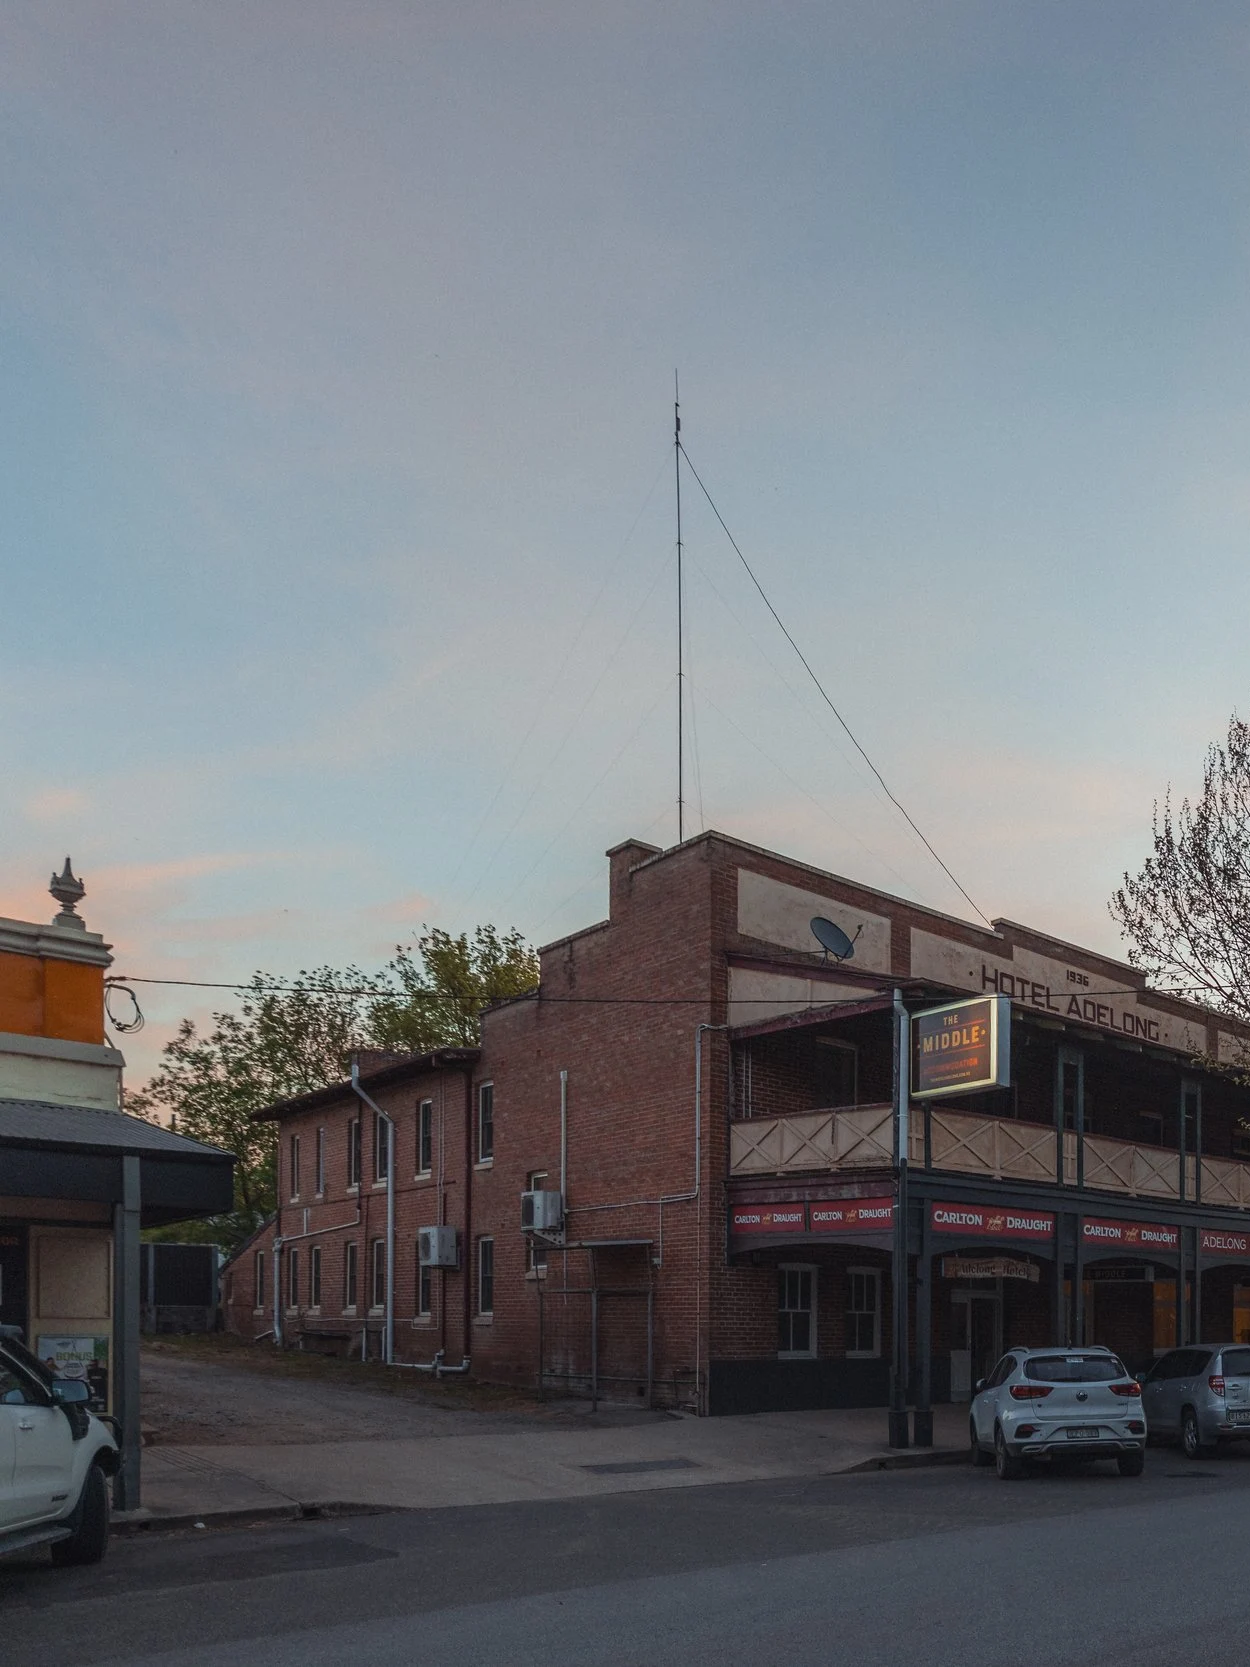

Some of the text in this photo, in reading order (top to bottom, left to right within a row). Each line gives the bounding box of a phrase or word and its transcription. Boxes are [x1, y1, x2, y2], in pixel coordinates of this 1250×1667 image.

[1066, 969, 1089, 987] 1936
[982, 964, 1159, 1042] HOTEL ADELONG
[943, 1014, 959, 1026] THE
[923, 1025, 980, 1053] MIDDLE
[734, 1212, 803, 1224] CARLTON DRAUGHT
[812, 1208, 892, 1221] CARLTON DRAUGHT
[933, 1210, 1053, 1232] CARLTON DRAUGHT
[1083, 1224, 1177, 1243] CARLTON DRAUGHT
[1202, 1236, 1247, 1250] ADELONG
[56, 1351, 93, 1361] BONUS
